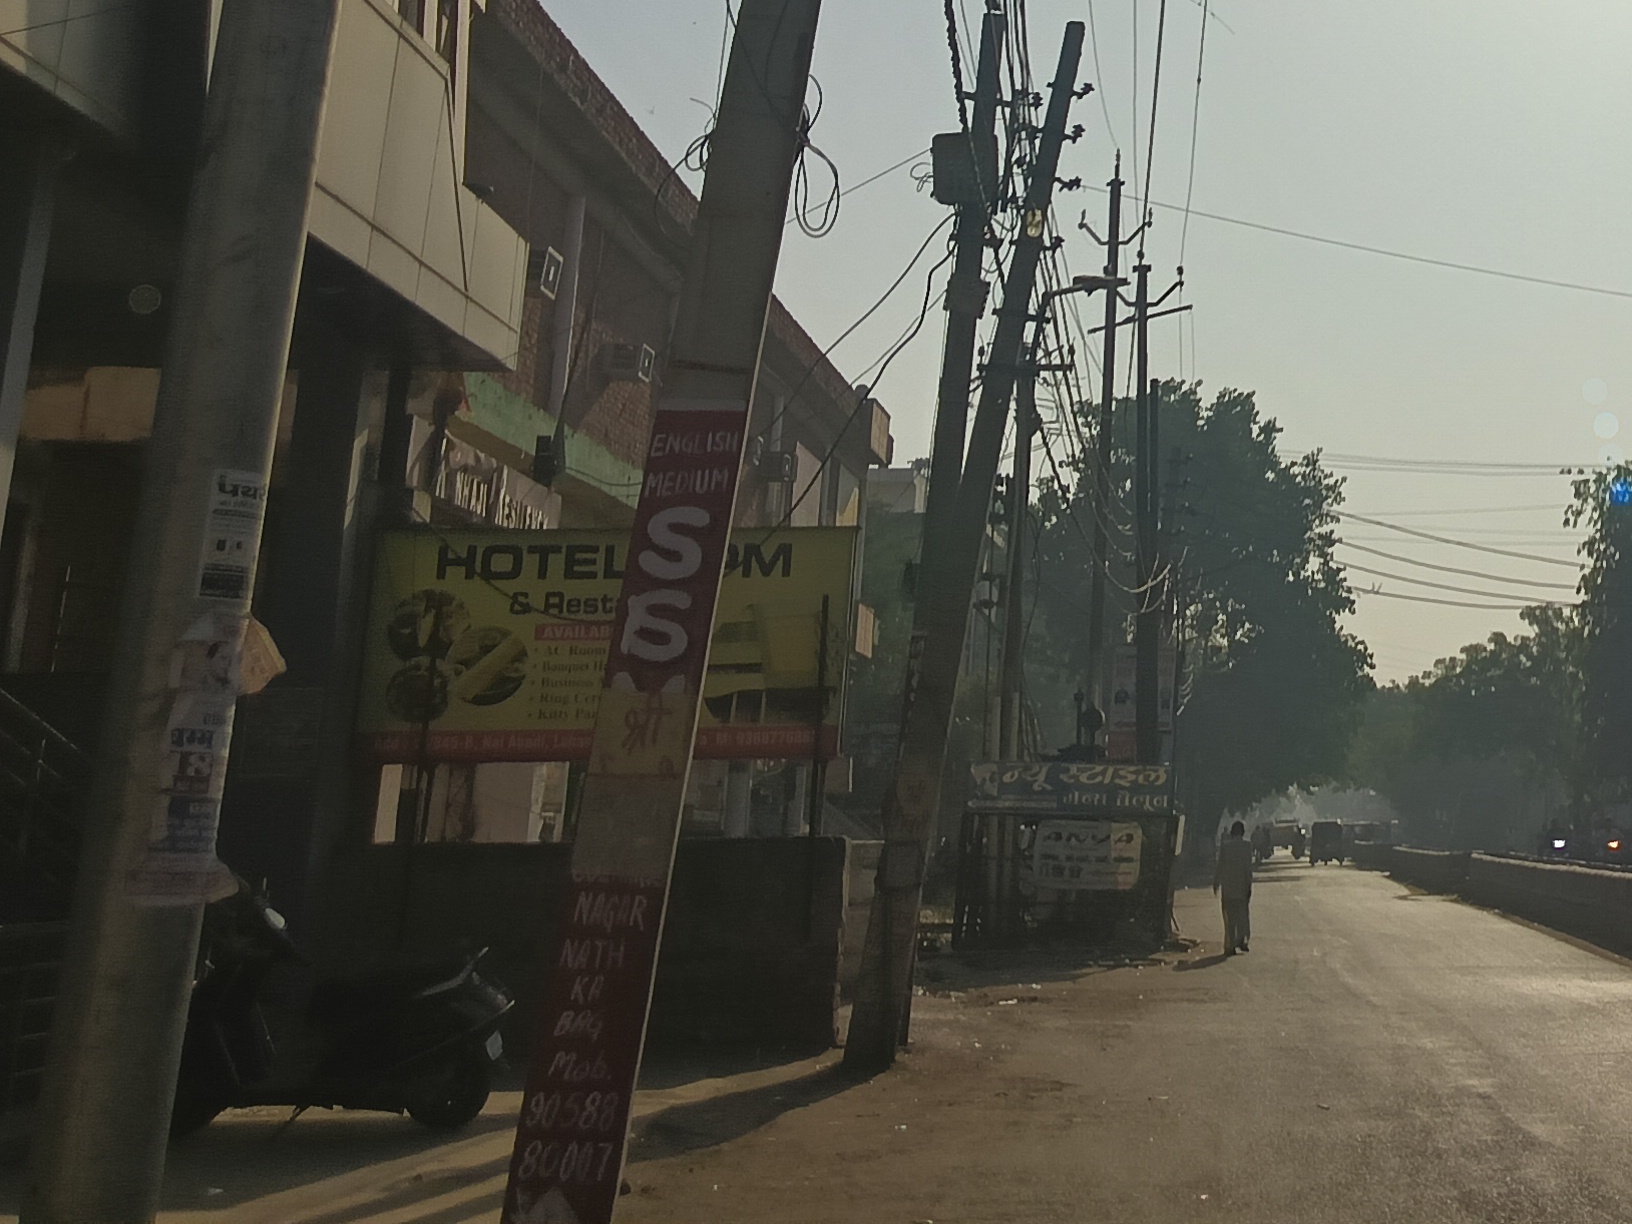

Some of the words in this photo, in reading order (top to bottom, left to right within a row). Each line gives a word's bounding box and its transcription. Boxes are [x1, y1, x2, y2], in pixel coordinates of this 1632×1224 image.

[649, 430, 739, 458] ENGLISH
[643, 467, 729, 499] MEDIUM
[436, 545, 624, 580] HOTEL
[509, 591, 536, 614] &
[541, 677, 594, 687] Business
[1001, 764, 1053, 792] न्यू
[1058, 764, 1170, 787] स्टाइल
[573, 891, 648, 932] NAGAR
[559, 936, 626, 969] NATH
[553, 1009, 604, 1041] BAG
[547, 1050, 612, 1081] Mob.
[525, 1091, 619, 1132] 90588
